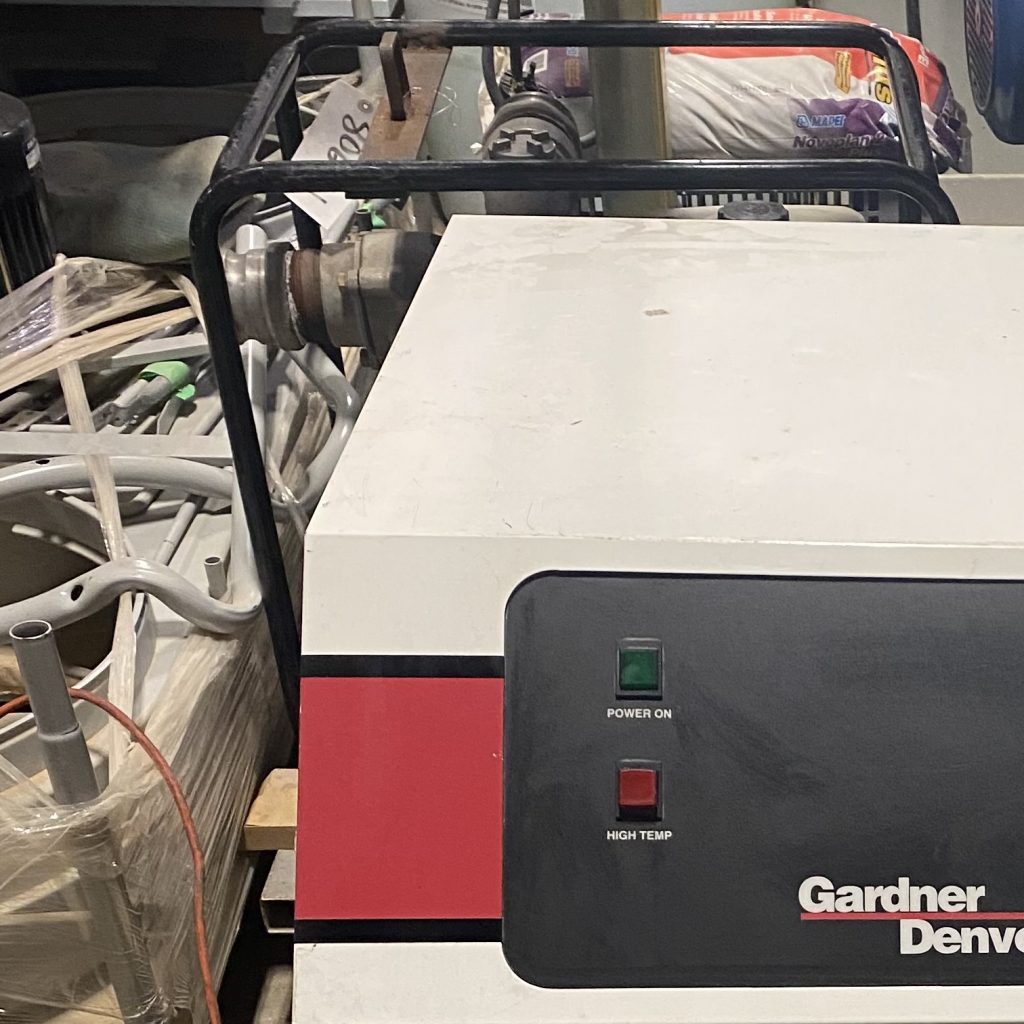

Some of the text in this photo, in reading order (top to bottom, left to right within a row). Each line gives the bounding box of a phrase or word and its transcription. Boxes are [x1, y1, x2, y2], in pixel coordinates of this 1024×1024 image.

[811, 115, 845, 127] MAPEI
[606, 708, 673, 719] POWER ON
[606, 830, 673, 841] HIGH TEMP
[798, 875, 986, 914] Gardner
